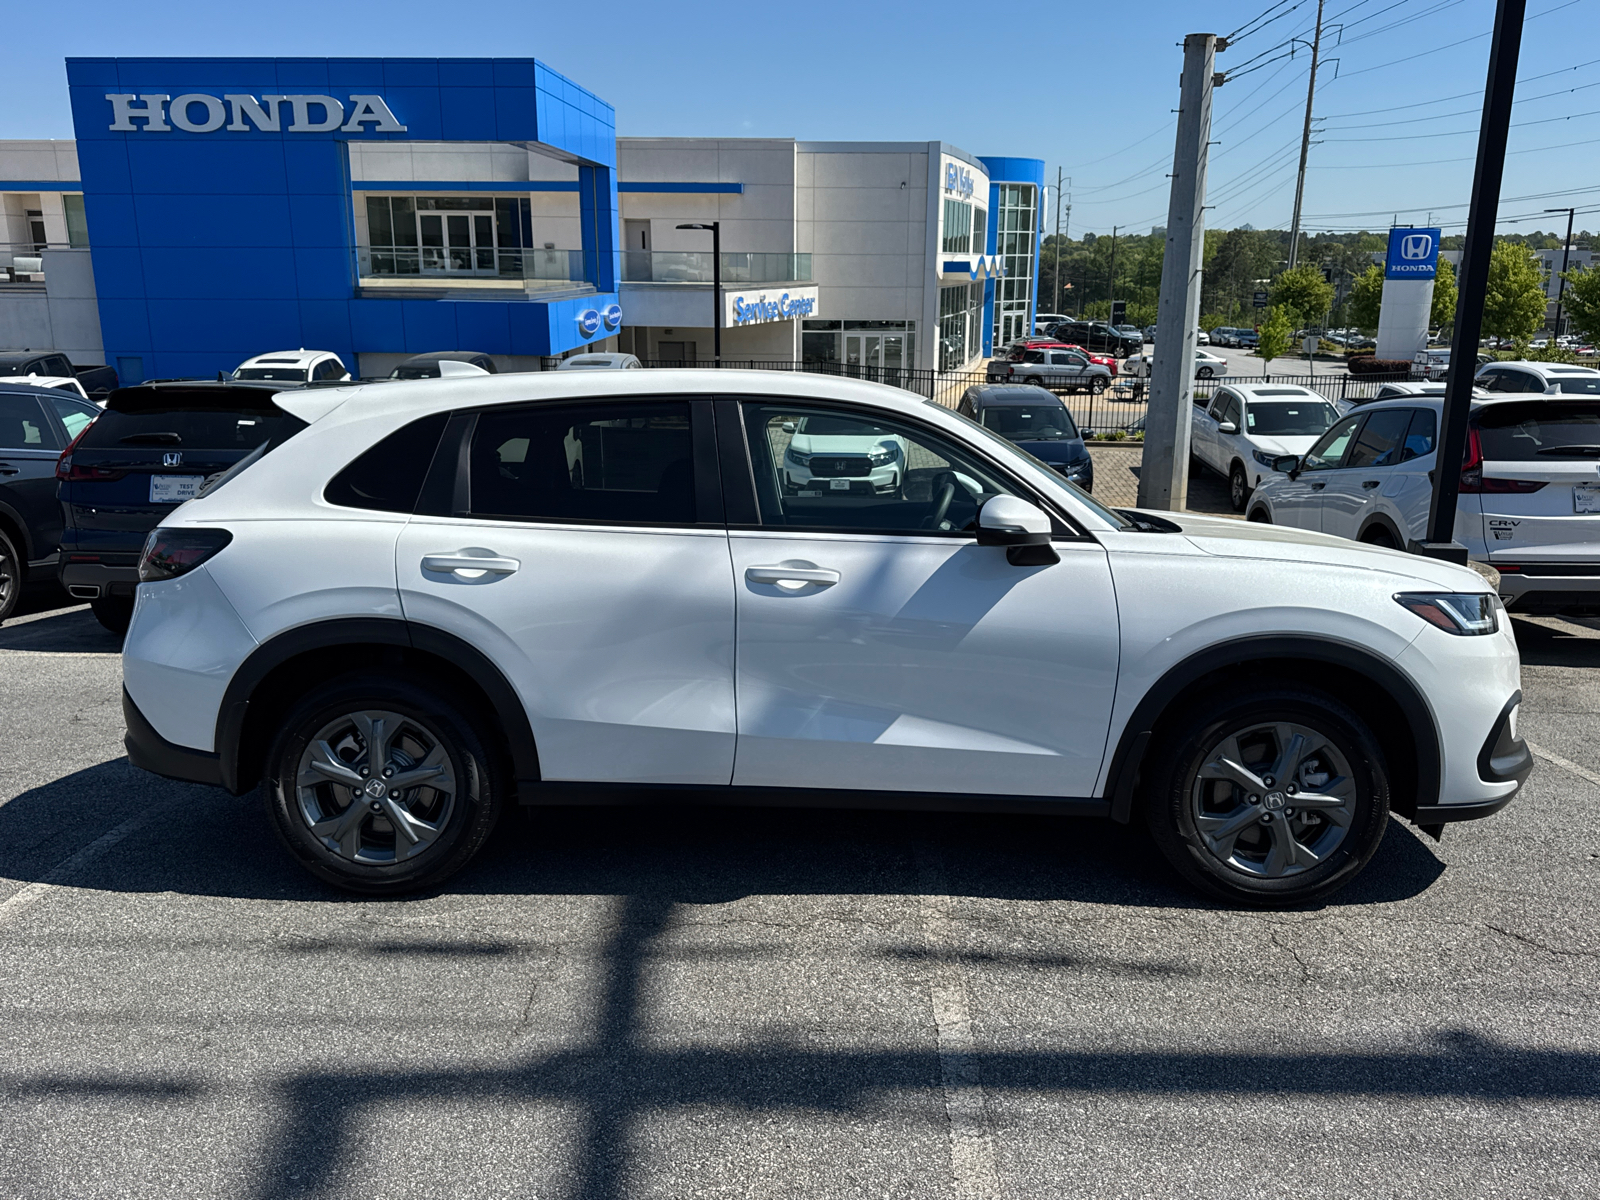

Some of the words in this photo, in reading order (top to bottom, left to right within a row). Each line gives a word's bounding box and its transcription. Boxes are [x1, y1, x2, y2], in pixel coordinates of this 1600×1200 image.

[105, 93, 408, 133] HONDA
[1391, 264, 1435, 272] HONDA
[735, 294, 778, 322] Service
[780, 292, 816, 317] Center
